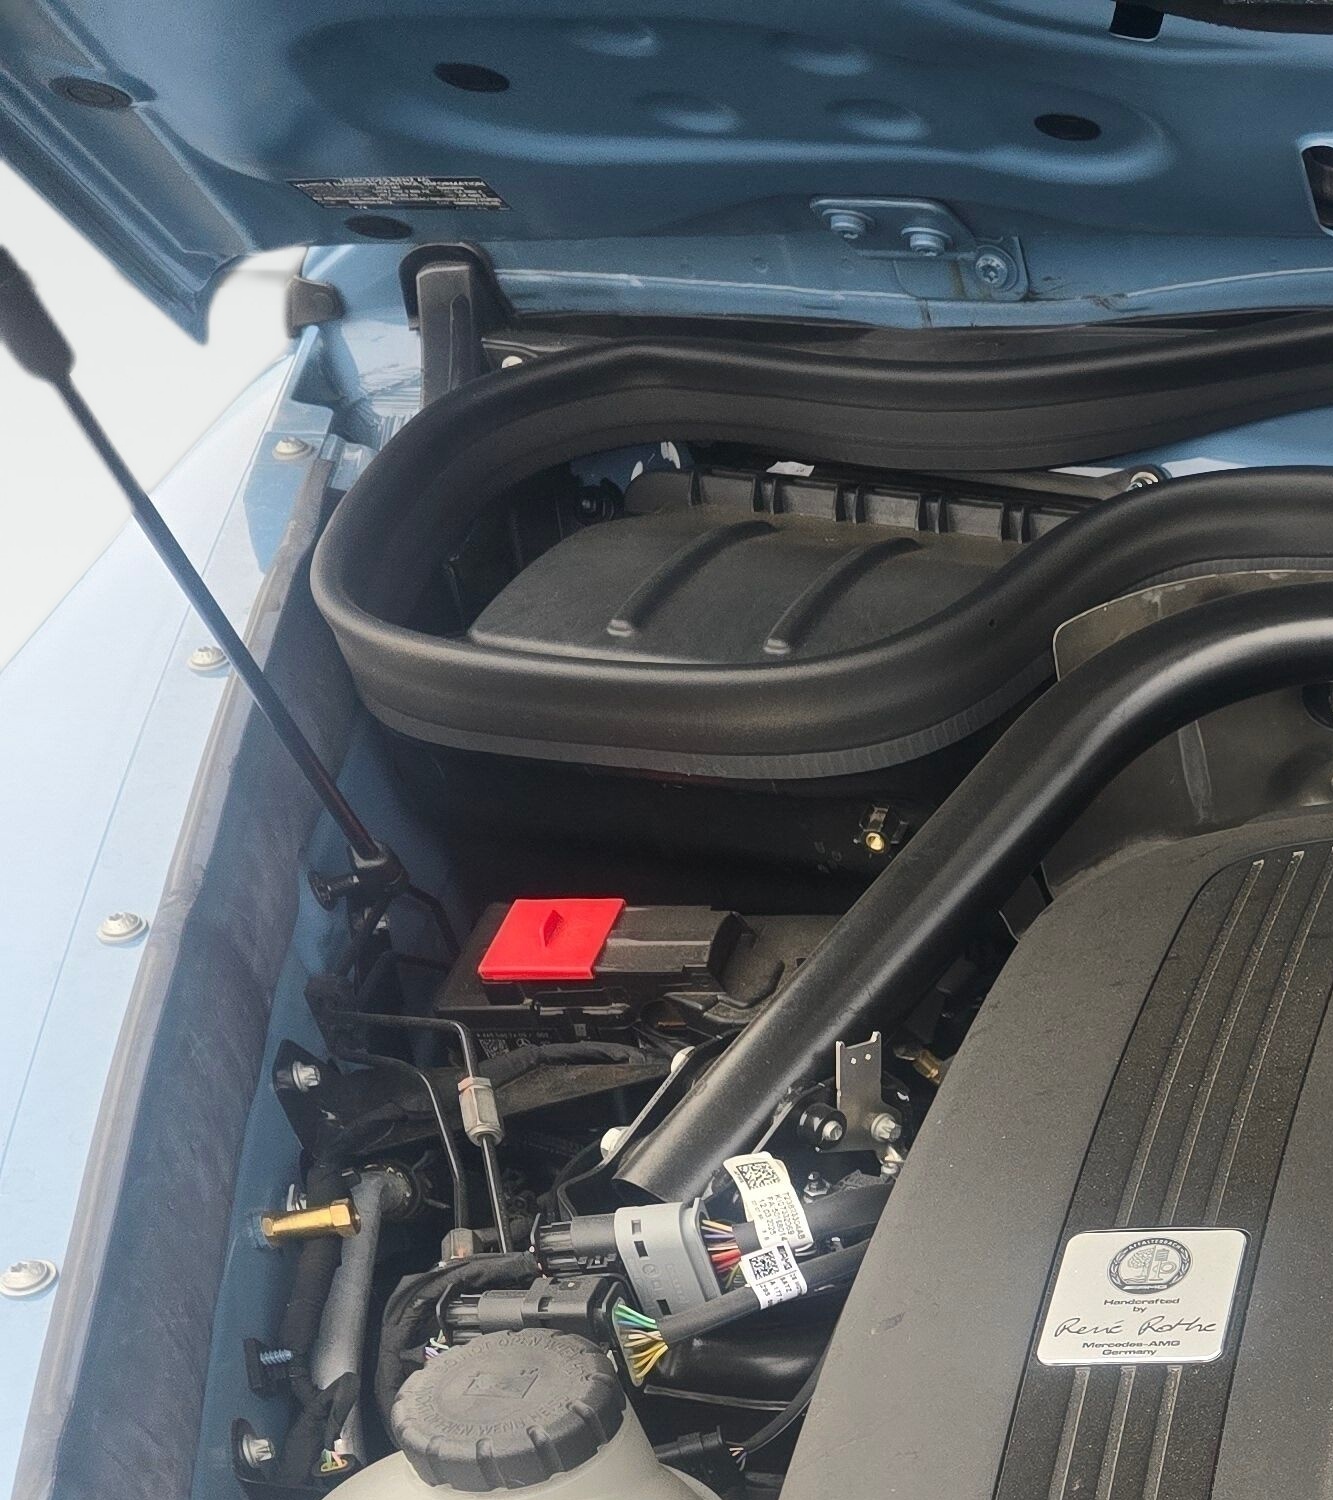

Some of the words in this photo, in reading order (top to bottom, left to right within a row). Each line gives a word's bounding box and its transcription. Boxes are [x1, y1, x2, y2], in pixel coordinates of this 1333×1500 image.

[1104, 1298, 1180, 1306] Handcrafted
[1132, 1306, 1148, 1314] by
[1054, 1317, 1125, 1338] René
[1082, 1340, 1181, 1349] Mercedes-AMG
